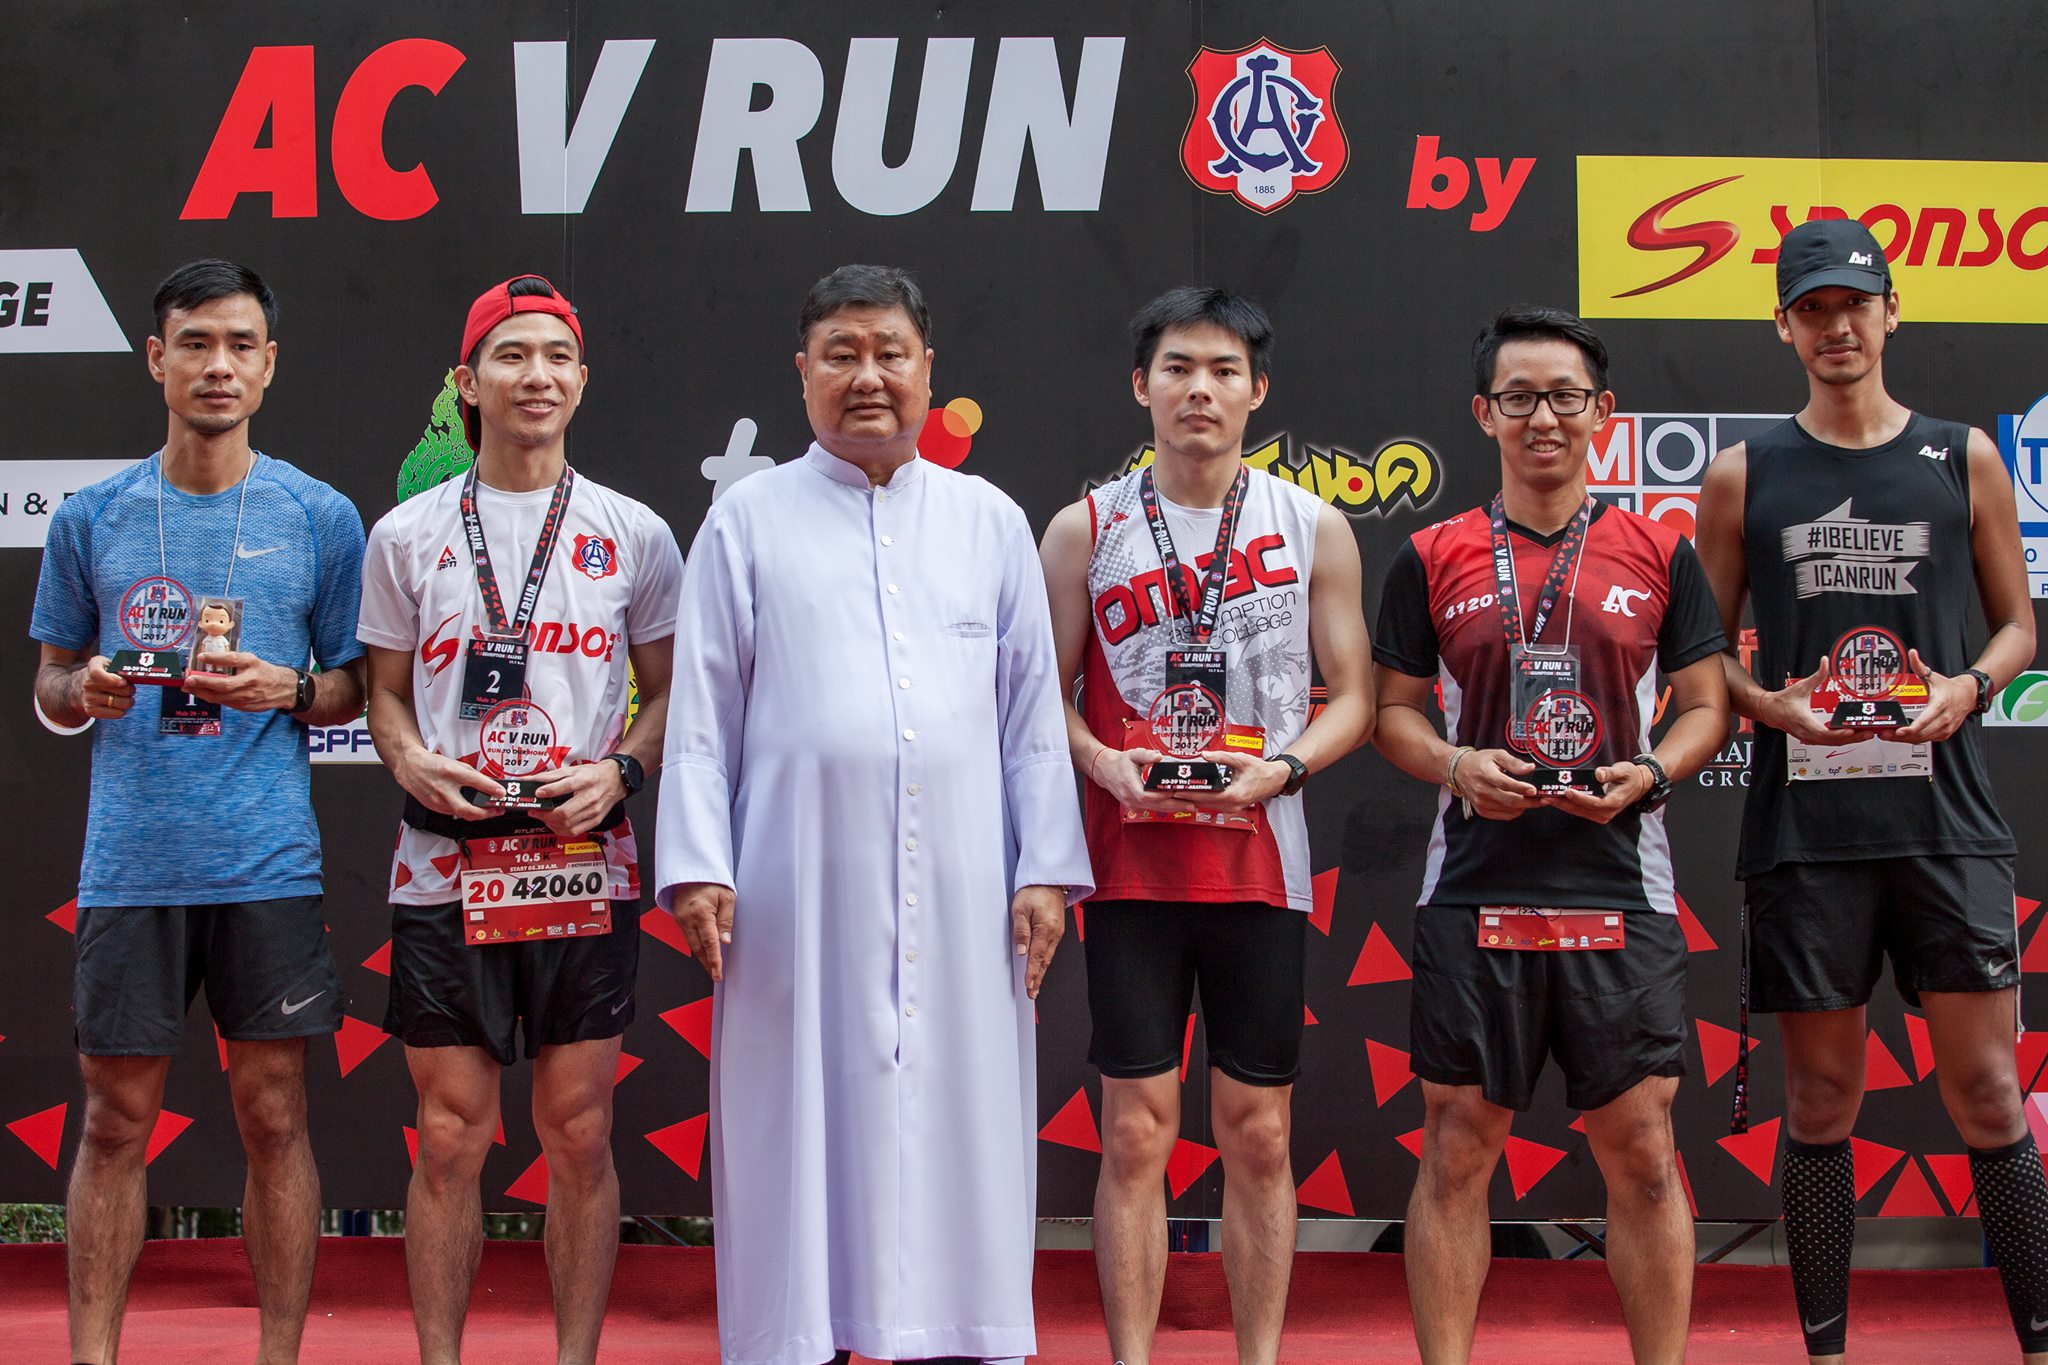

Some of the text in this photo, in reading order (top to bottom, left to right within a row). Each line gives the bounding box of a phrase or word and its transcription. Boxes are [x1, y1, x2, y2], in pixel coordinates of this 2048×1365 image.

[179, 36, 1126, 221] AC V RUN
[1254, 185, 1276, 194] 1885
[1406, 135, 1537, 232] by
[1750, 203, 2048, 271] SONSO
[1848, 251, 1873, 267] Ari
[1918, 445, 1949, 461] Ari
[1155, 530, 1173, 554] RUN
[1807, 526, 1905, 553] #IBELIEVE
[1494, 533, 1512, 581] AC V RUN
[1814, 563, 1897, 591] ICANRUN
[1203, 587, 1221, 614] RUN
[127, 607, 187, 620] AC V RUN
[1200, 614, 1210, 625] V
[143, 633, 167, 641] 2017
[472, 641, 515, 654] AC V RUN
[144, 655, 150, 663] 1
[1170, 653, 1212, 663] AC V RUN
[1520, 661, 1562, 671] AC V RUN
[486, 670, 501, 694] 2
[1157, 715, 1220, 728] AC V RUN
[1533, 721, 1595, 734] AC V RUN
[309, 728, 372, 753] CPF
[487, 730, 550, 746] AC V RUN
[504, 758, 529, 767] 2017
[1180, 767, 1188, 776] 3
[510, 784, 517, 793] 2
[501, 839, 519, 852] AC
[521, 838, 530, 850] V
[531, 837, 557, 849] RUN
[515, 852, 541, 863] 10.5
[468, 872, 603, 904] 20 42060
